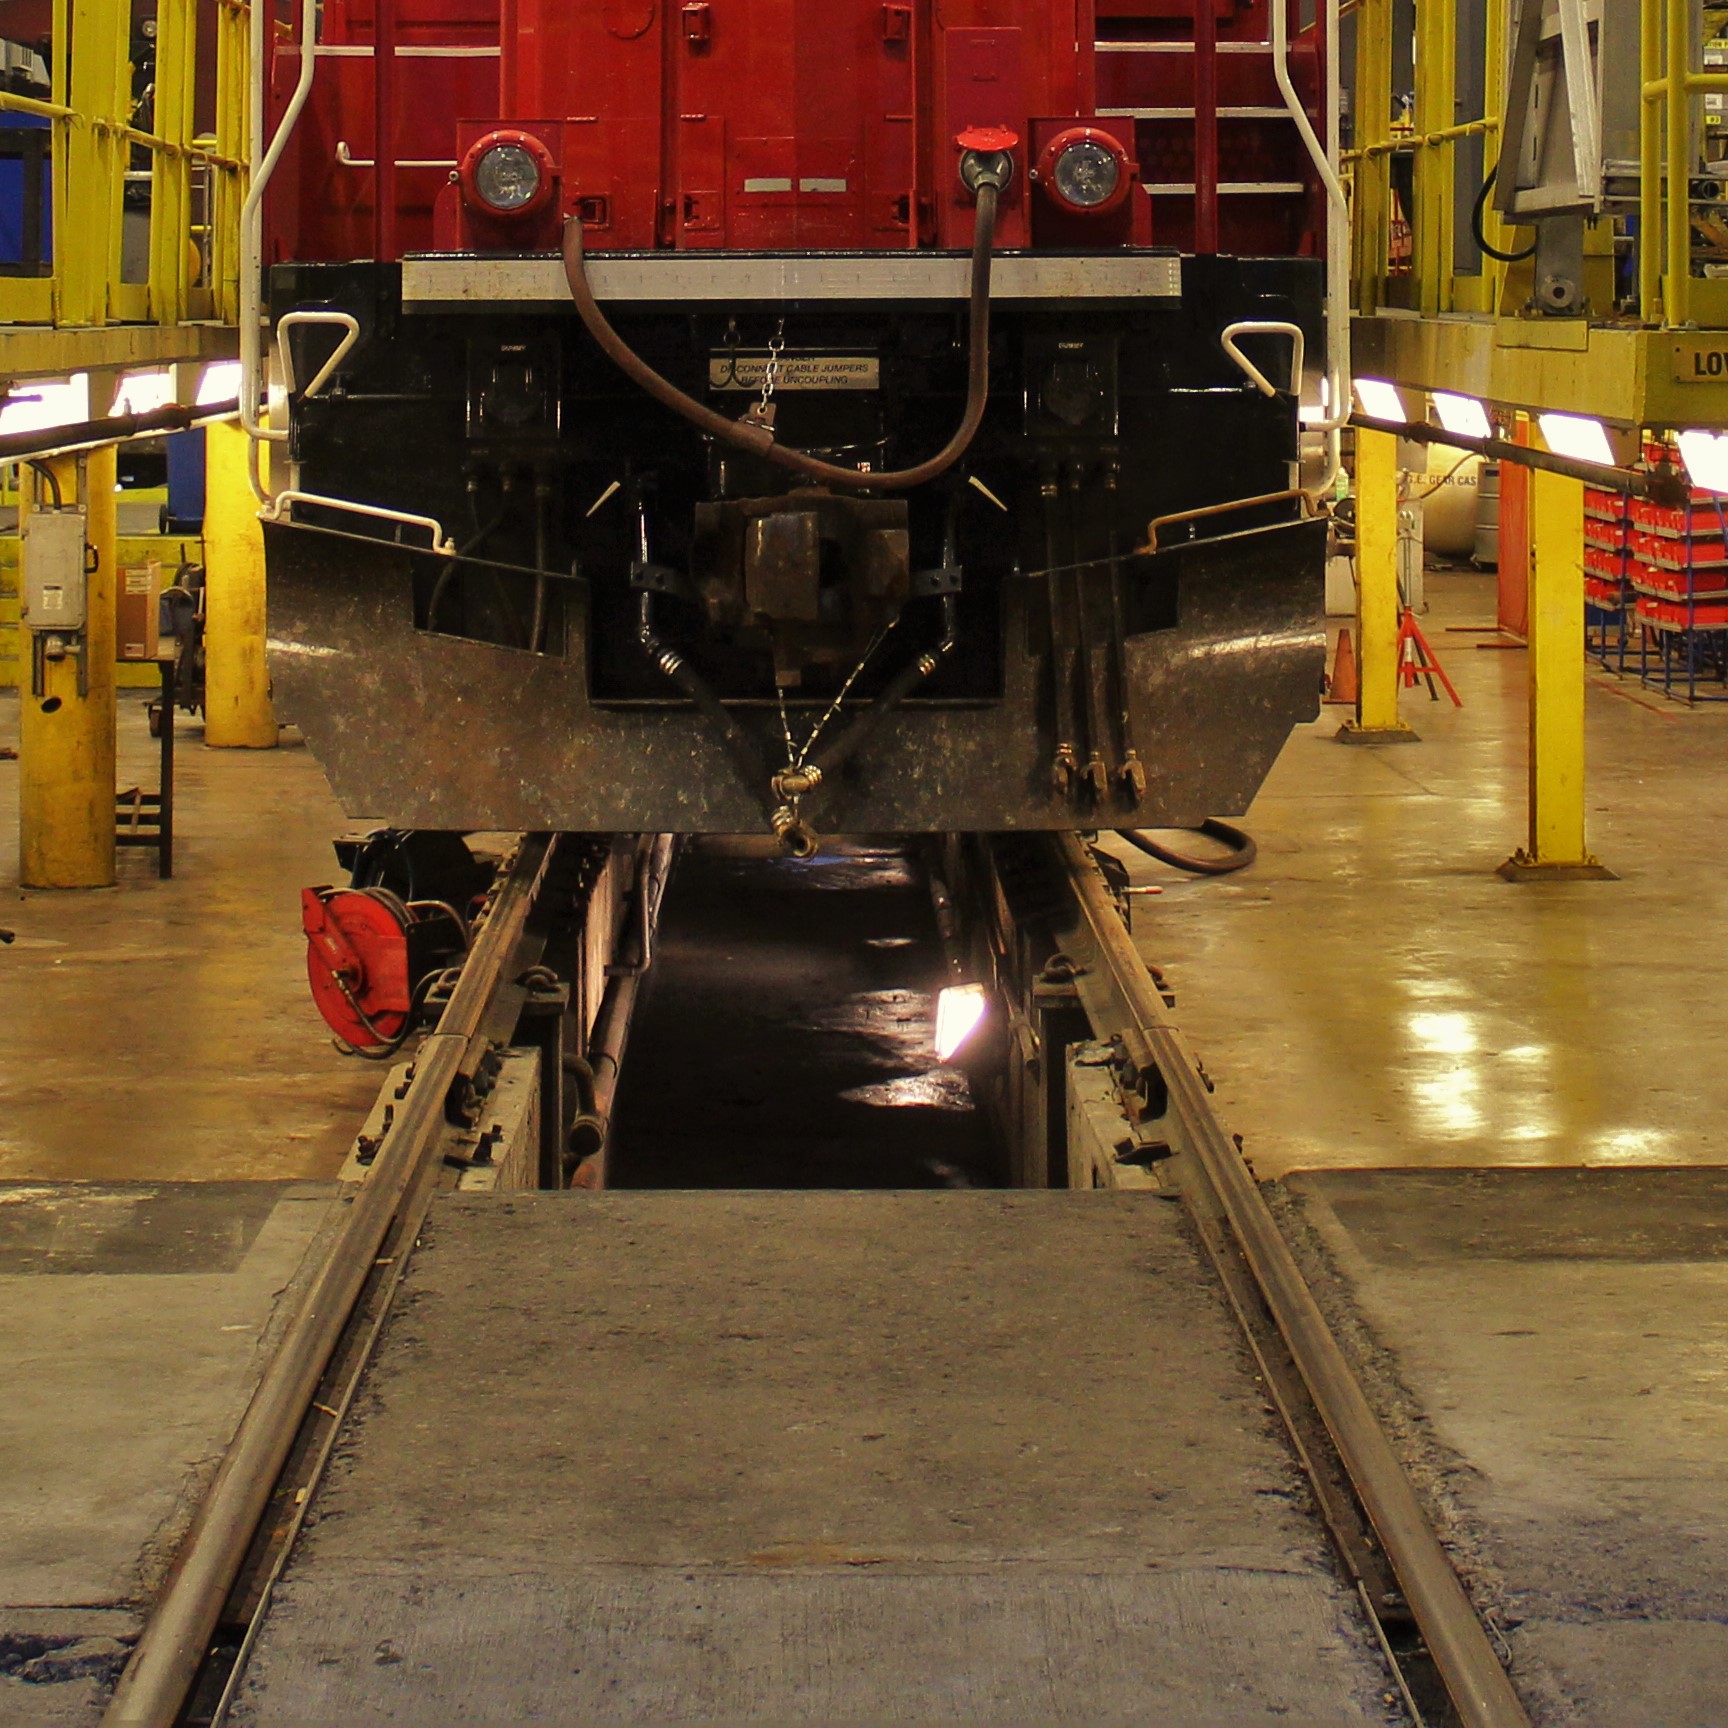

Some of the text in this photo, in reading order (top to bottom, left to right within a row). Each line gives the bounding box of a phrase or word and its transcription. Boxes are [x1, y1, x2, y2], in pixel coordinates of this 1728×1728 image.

[787, 364, 819, 373] CABLE
[821, 364, 869, 373] JUMPERS
[741, 375, 849, 384] BEFOE UNCOUPLING
